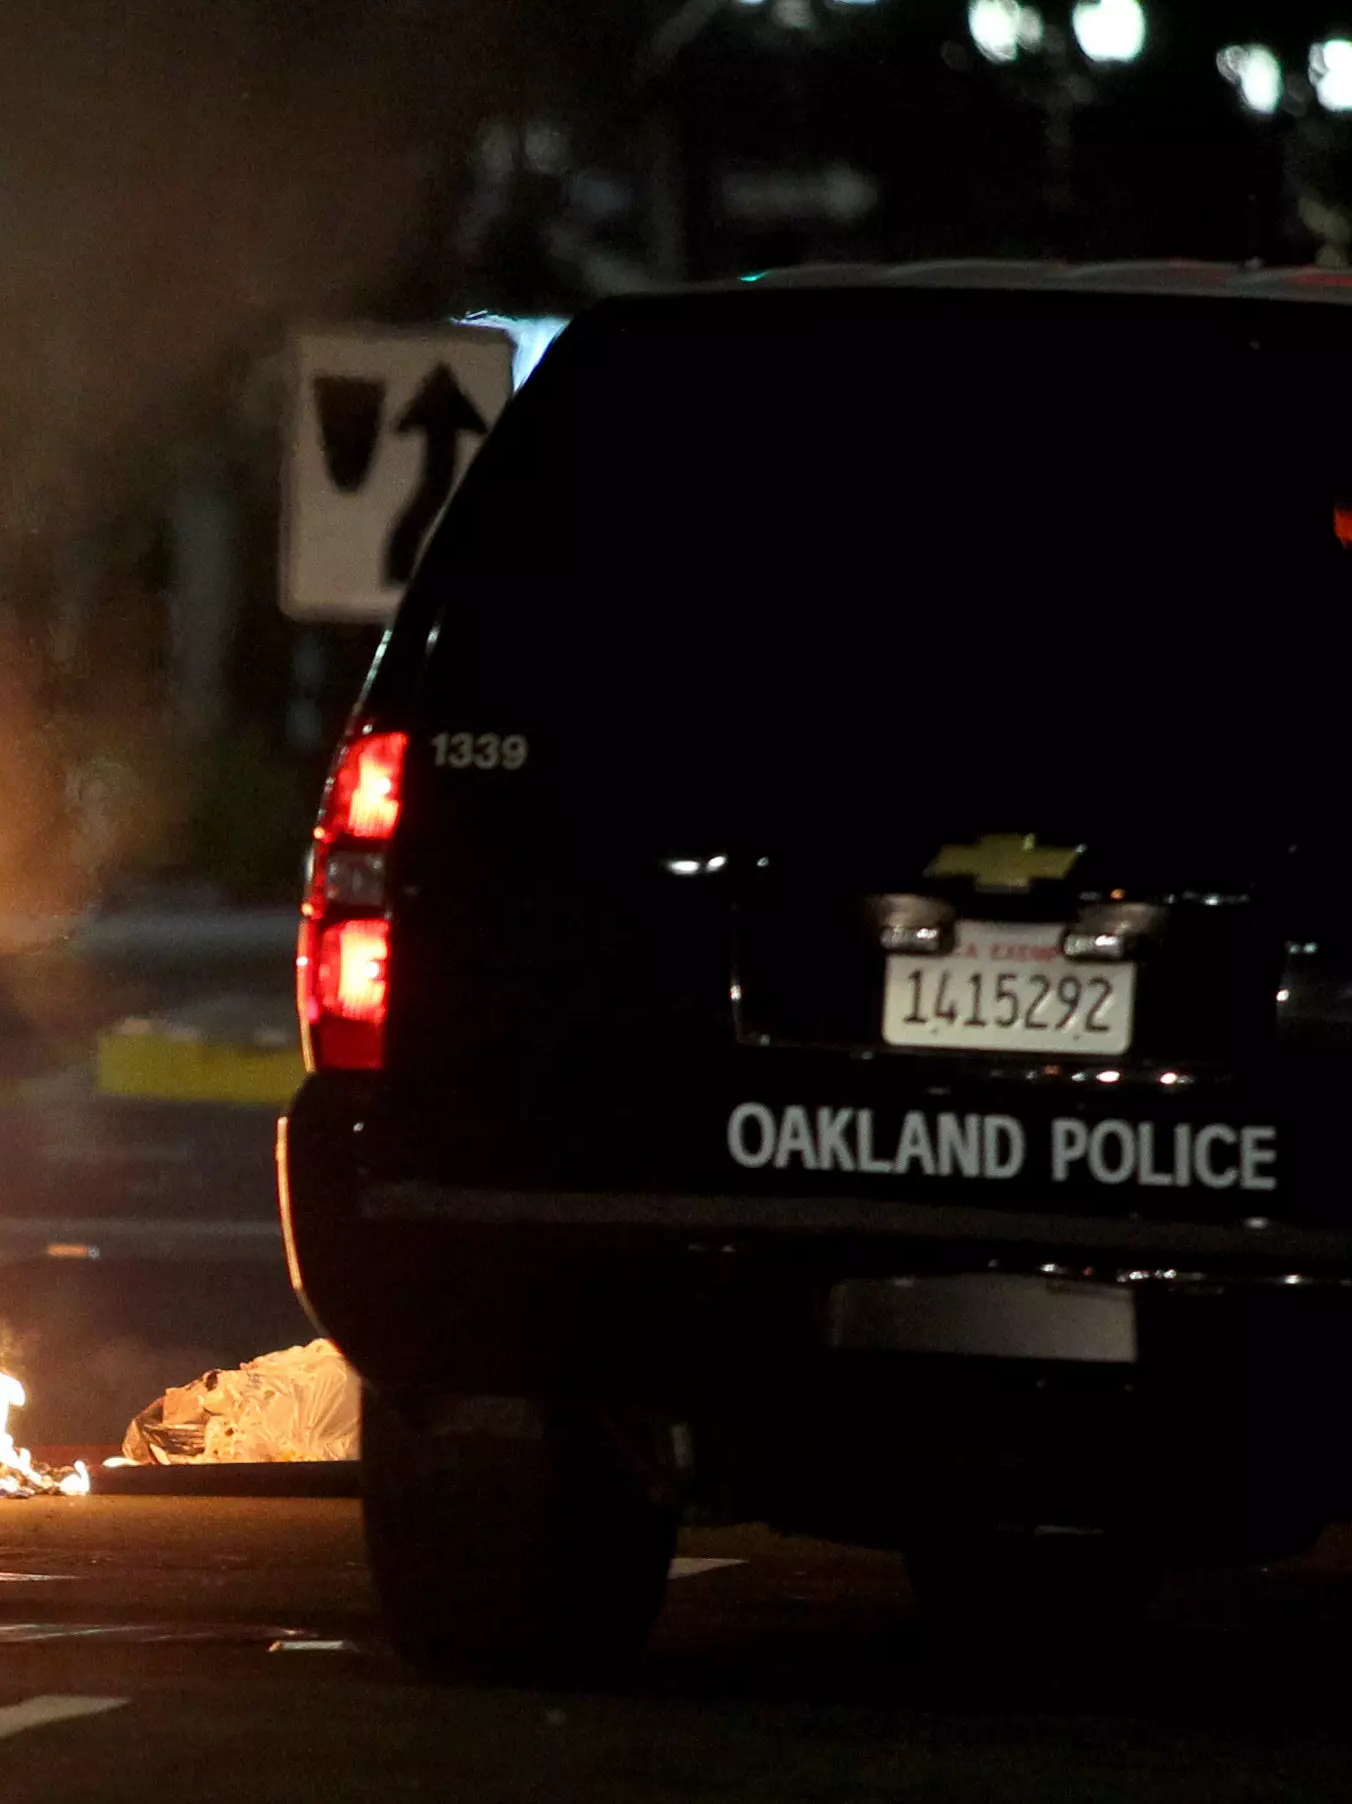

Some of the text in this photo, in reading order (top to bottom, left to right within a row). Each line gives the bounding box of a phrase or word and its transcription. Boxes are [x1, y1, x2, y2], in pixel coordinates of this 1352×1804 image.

[430, 731, 528, 770] 1339
[903, 968, 1113, 1032] 1415292
[727, 1102, 1277, 1190] OAKLAND POLICE
